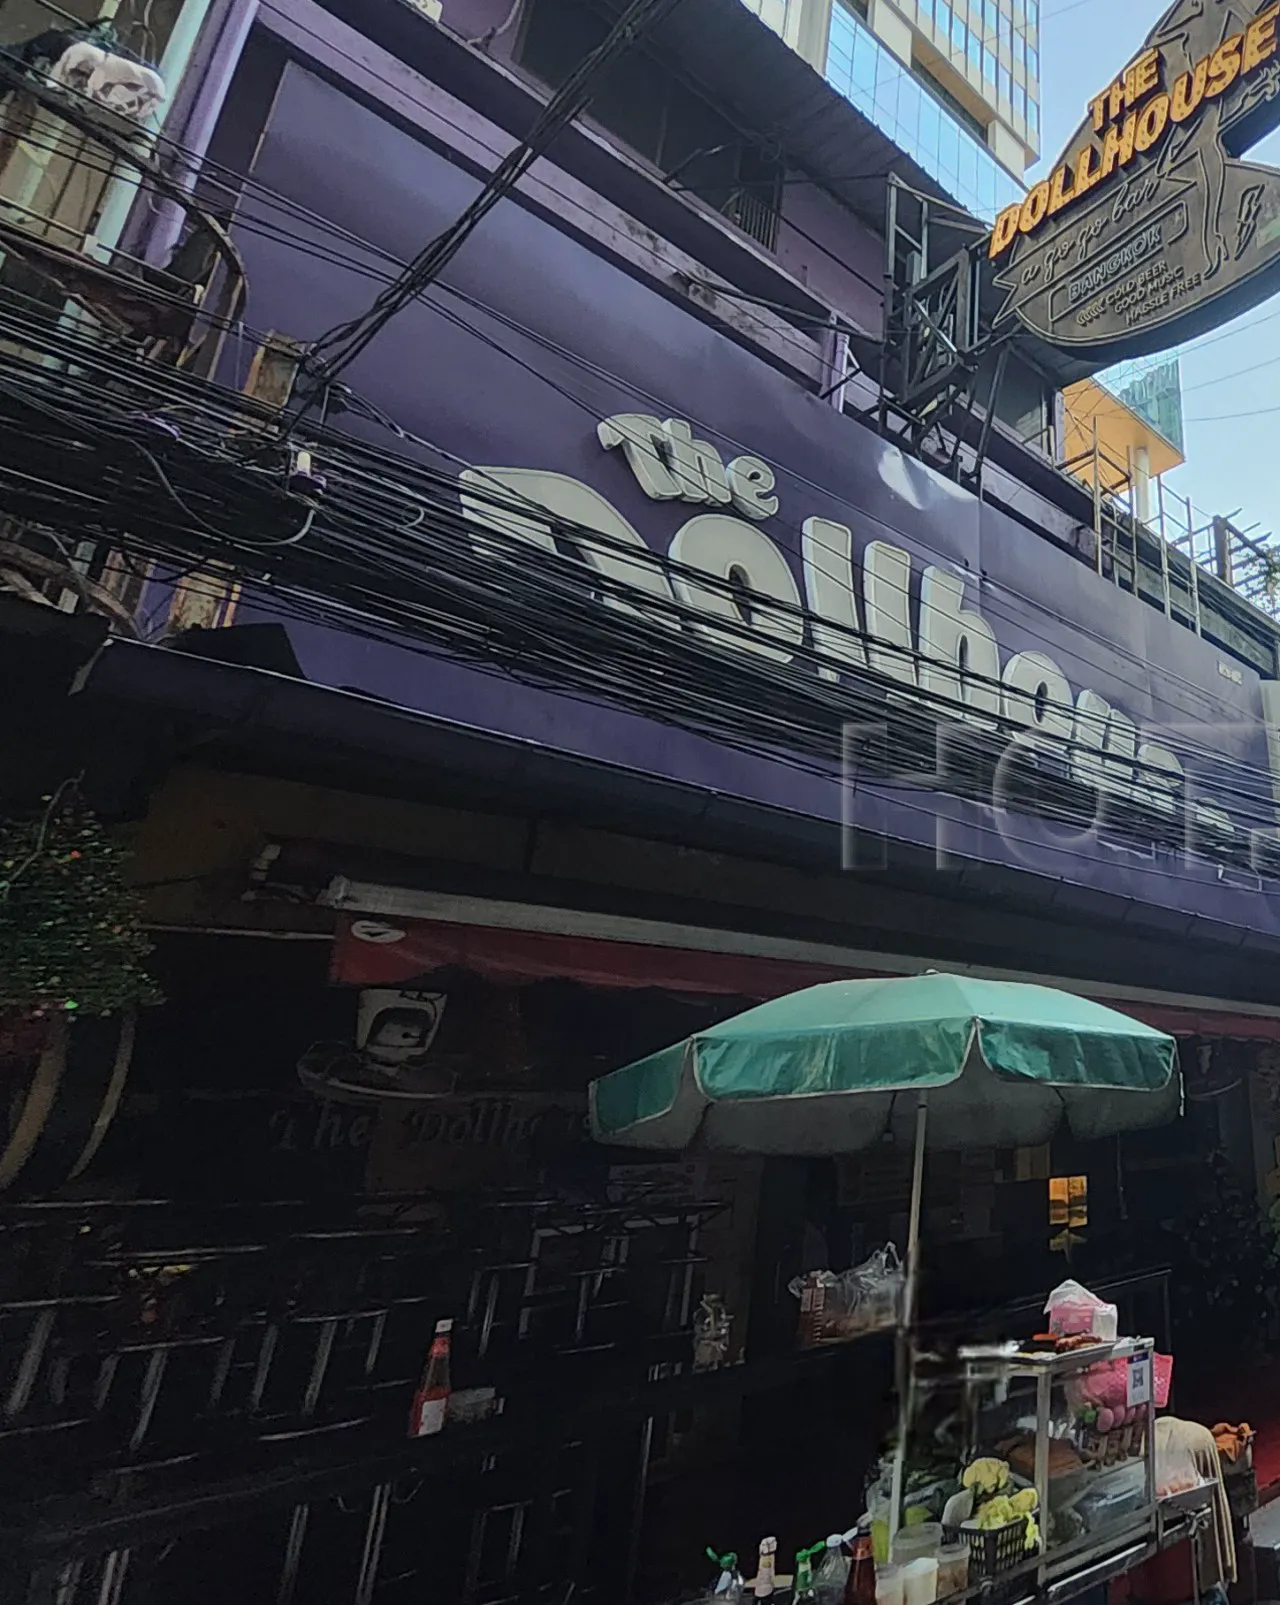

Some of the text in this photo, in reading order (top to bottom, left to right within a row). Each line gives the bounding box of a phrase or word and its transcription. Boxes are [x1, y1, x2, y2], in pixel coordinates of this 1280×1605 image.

[1090, 47, 1161, 130] THE
[1021, 177, 1157, 286] a go go bar
[1067, 224, 1163, 302] BANGKOK
[1105, 259, 1169, 305] COLD BEER
[1114, 287, 1145, 313] GOOD
[1169, 272, 1202, 300] FREE
[596, 411, 781, 522] The
